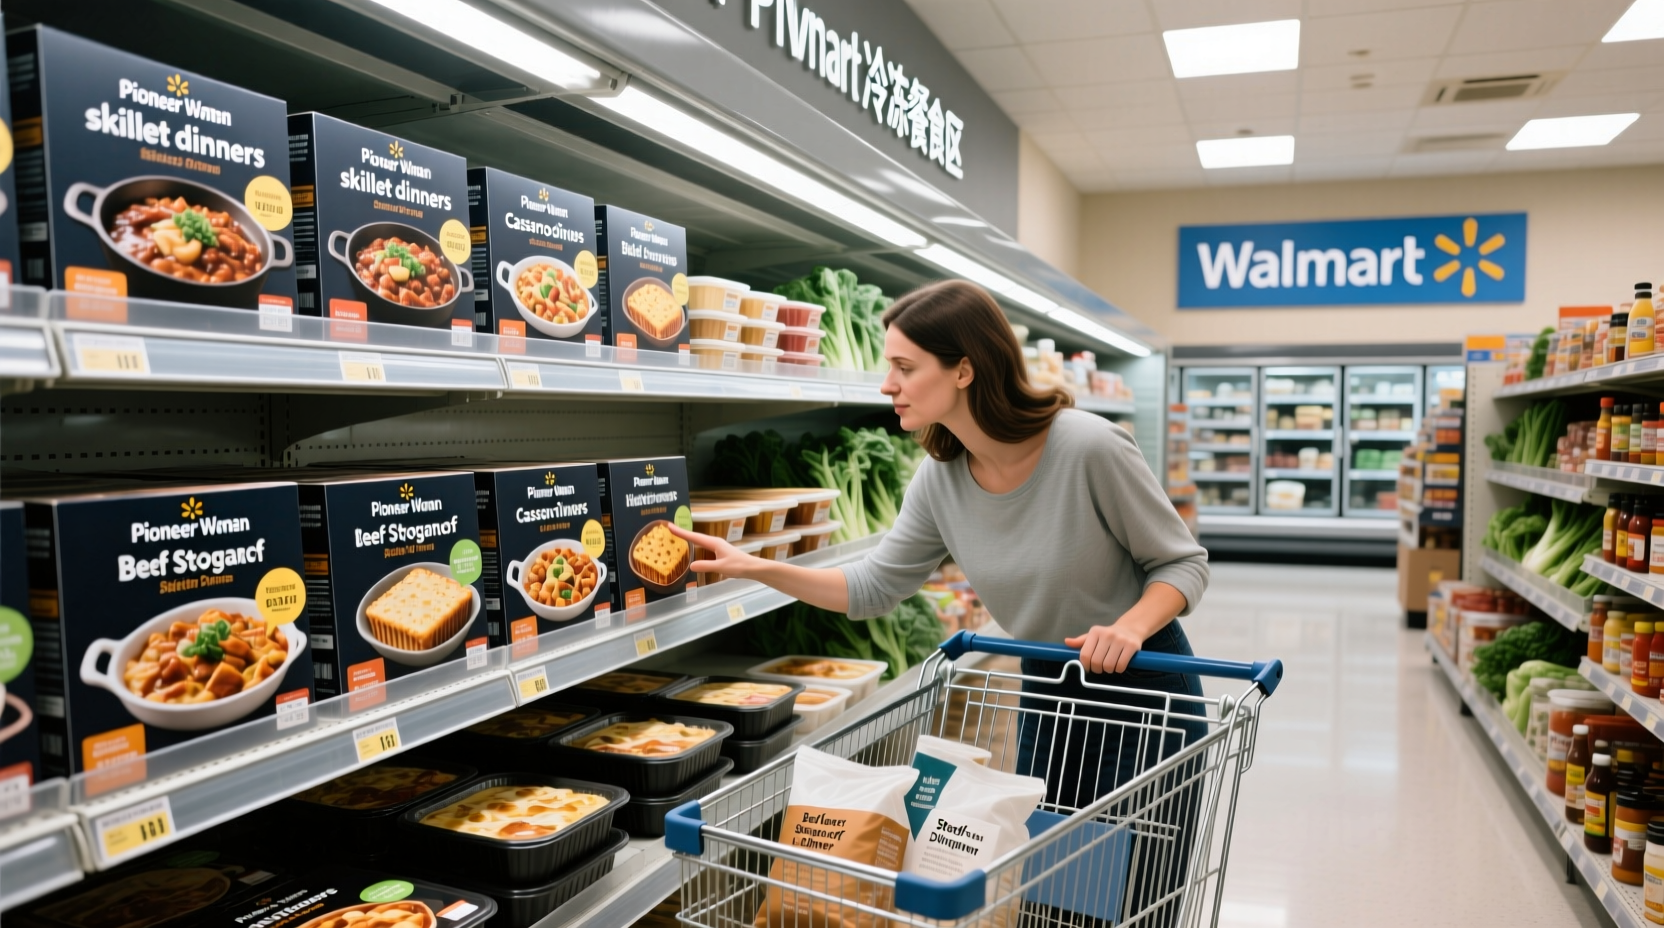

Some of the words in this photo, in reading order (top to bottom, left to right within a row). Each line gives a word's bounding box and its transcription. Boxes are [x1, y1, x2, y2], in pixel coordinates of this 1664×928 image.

[119, 78, 184, 114] Pioneer
[84, 102, 171, 148] skillet
[174, 124, 266, 169] dinners
[340, 167, 393, 199] skillet
[395, 179, 452, 211] dinners
[1197, 235, 1426, 290] Walmart
[131, 521, 199, 543] Pioneer
[117, 550, 170, 582] Beef
